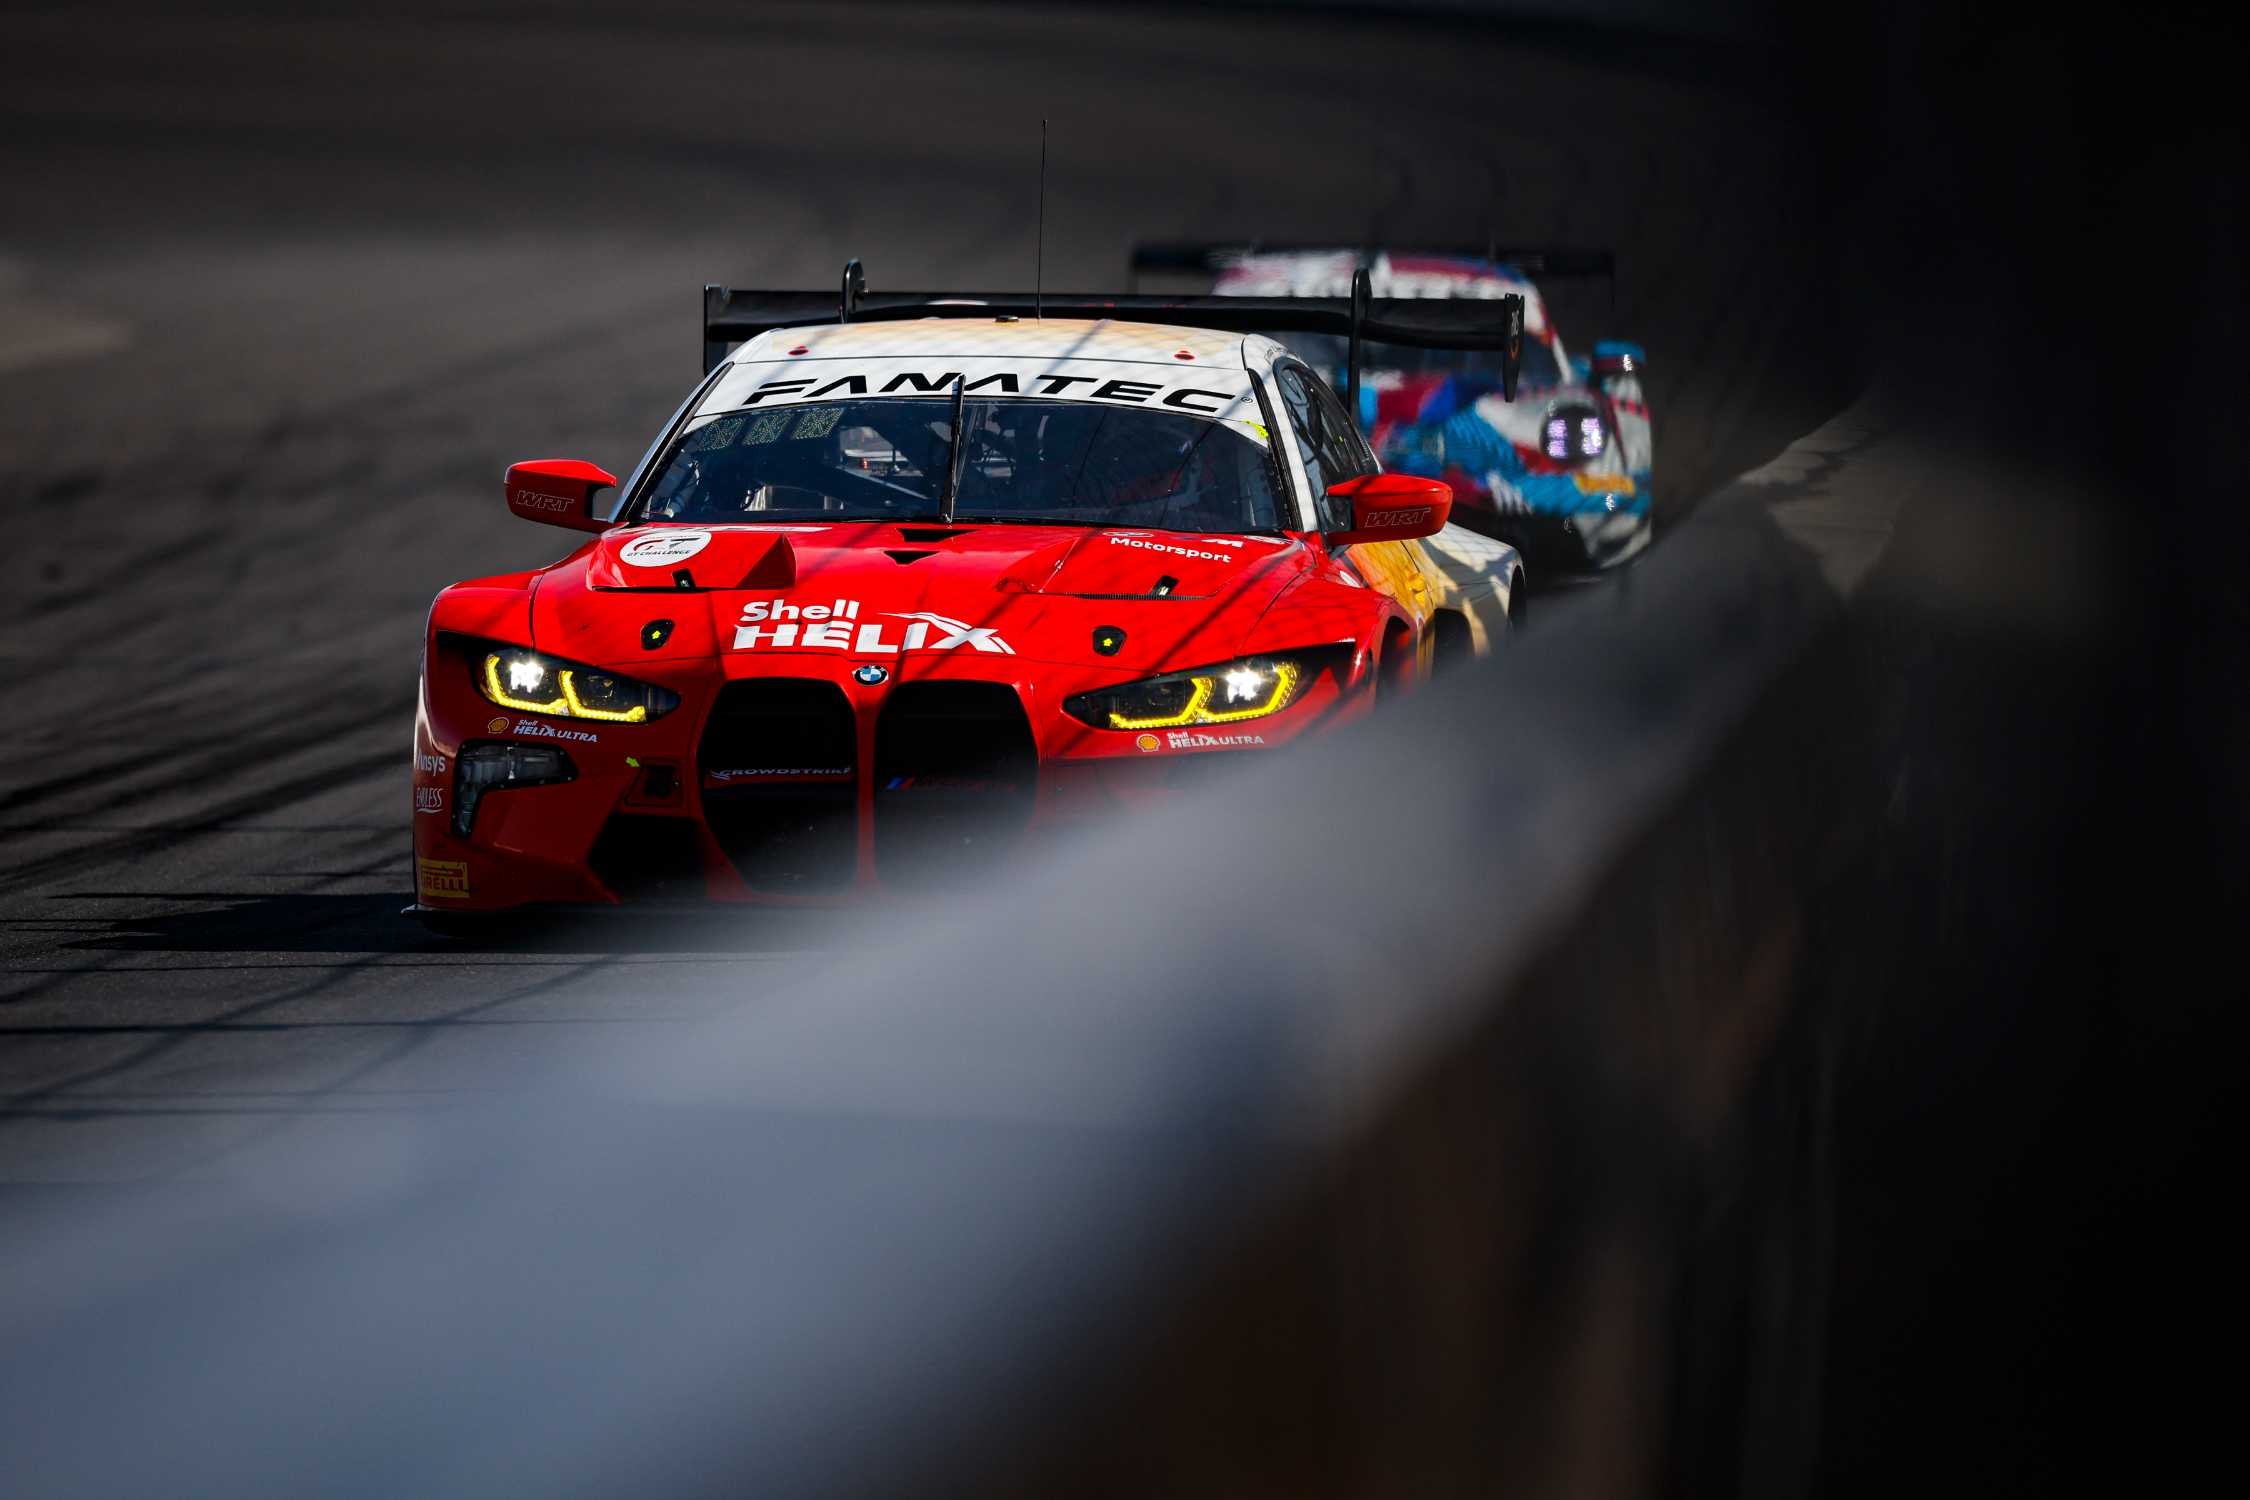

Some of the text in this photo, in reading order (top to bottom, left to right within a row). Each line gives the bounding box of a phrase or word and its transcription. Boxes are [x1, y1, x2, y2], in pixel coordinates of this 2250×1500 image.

[743, 372, 1237, 413] FANATEC
[515, 490, 576, 512] WRT
[1364, 506, 1432, 529] WRT
[1110, 537, 1233, 563] Motorsport
[740, 598, 860, 622] Shell
[733, 611, 1017, 656] HELIX
[512, 724, 599, 743] HELIX ULTRA
[518, 719, 539, 727] Shell
[1167, 731, 1189, 741] Shell
[1168, 733, 1265, 749] HELIX ULTRA
